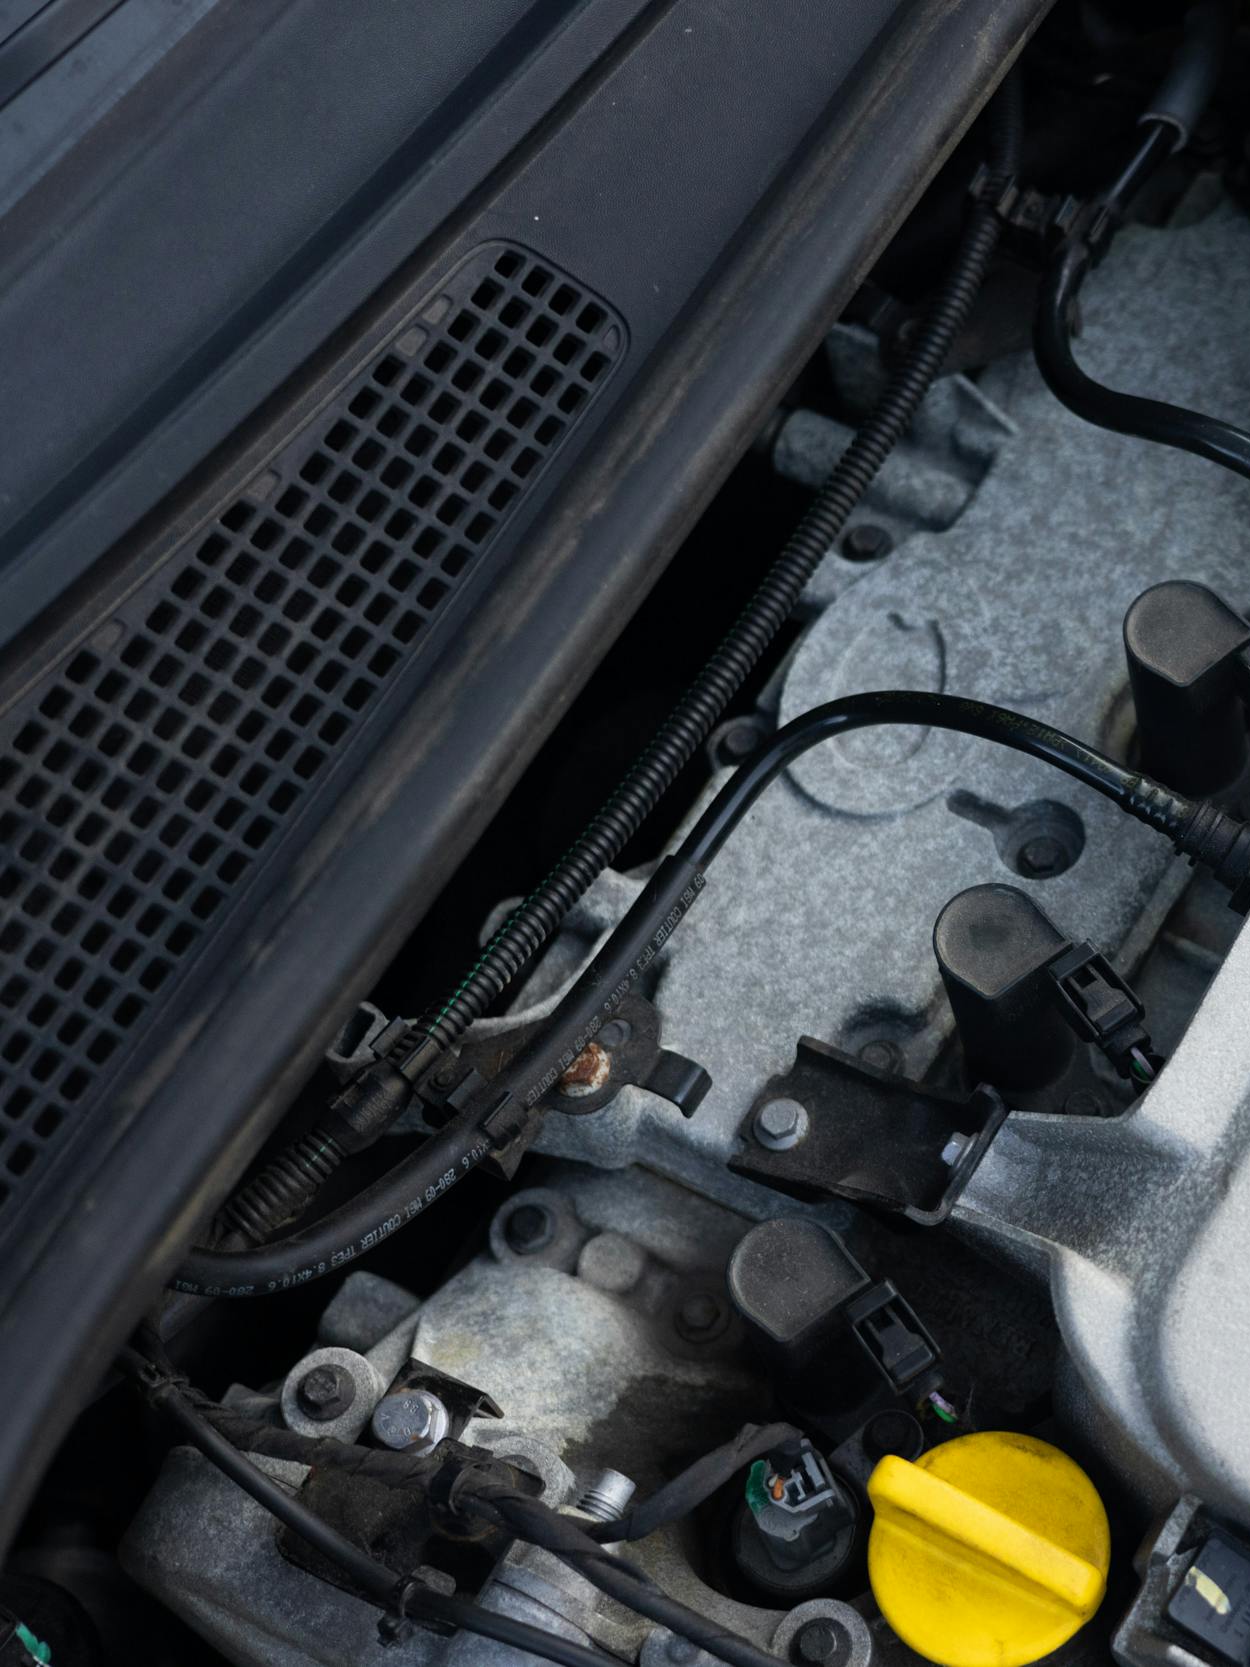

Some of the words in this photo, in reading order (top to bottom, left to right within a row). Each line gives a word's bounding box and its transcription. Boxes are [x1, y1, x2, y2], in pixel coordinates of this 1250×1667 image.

[652, 905, 682, 947] COUTIER
[424, 1167, 457, 1202] 280-09
[405, 1196, 424, 1218] MGI
[360, 1213, 402, 1249] COUTIER
[331, 1245, 357, 1266] TPE3
[204, 1285, 255, 1296] 280-09
[268, 1262, 326, 1291] 8.4X10.6
